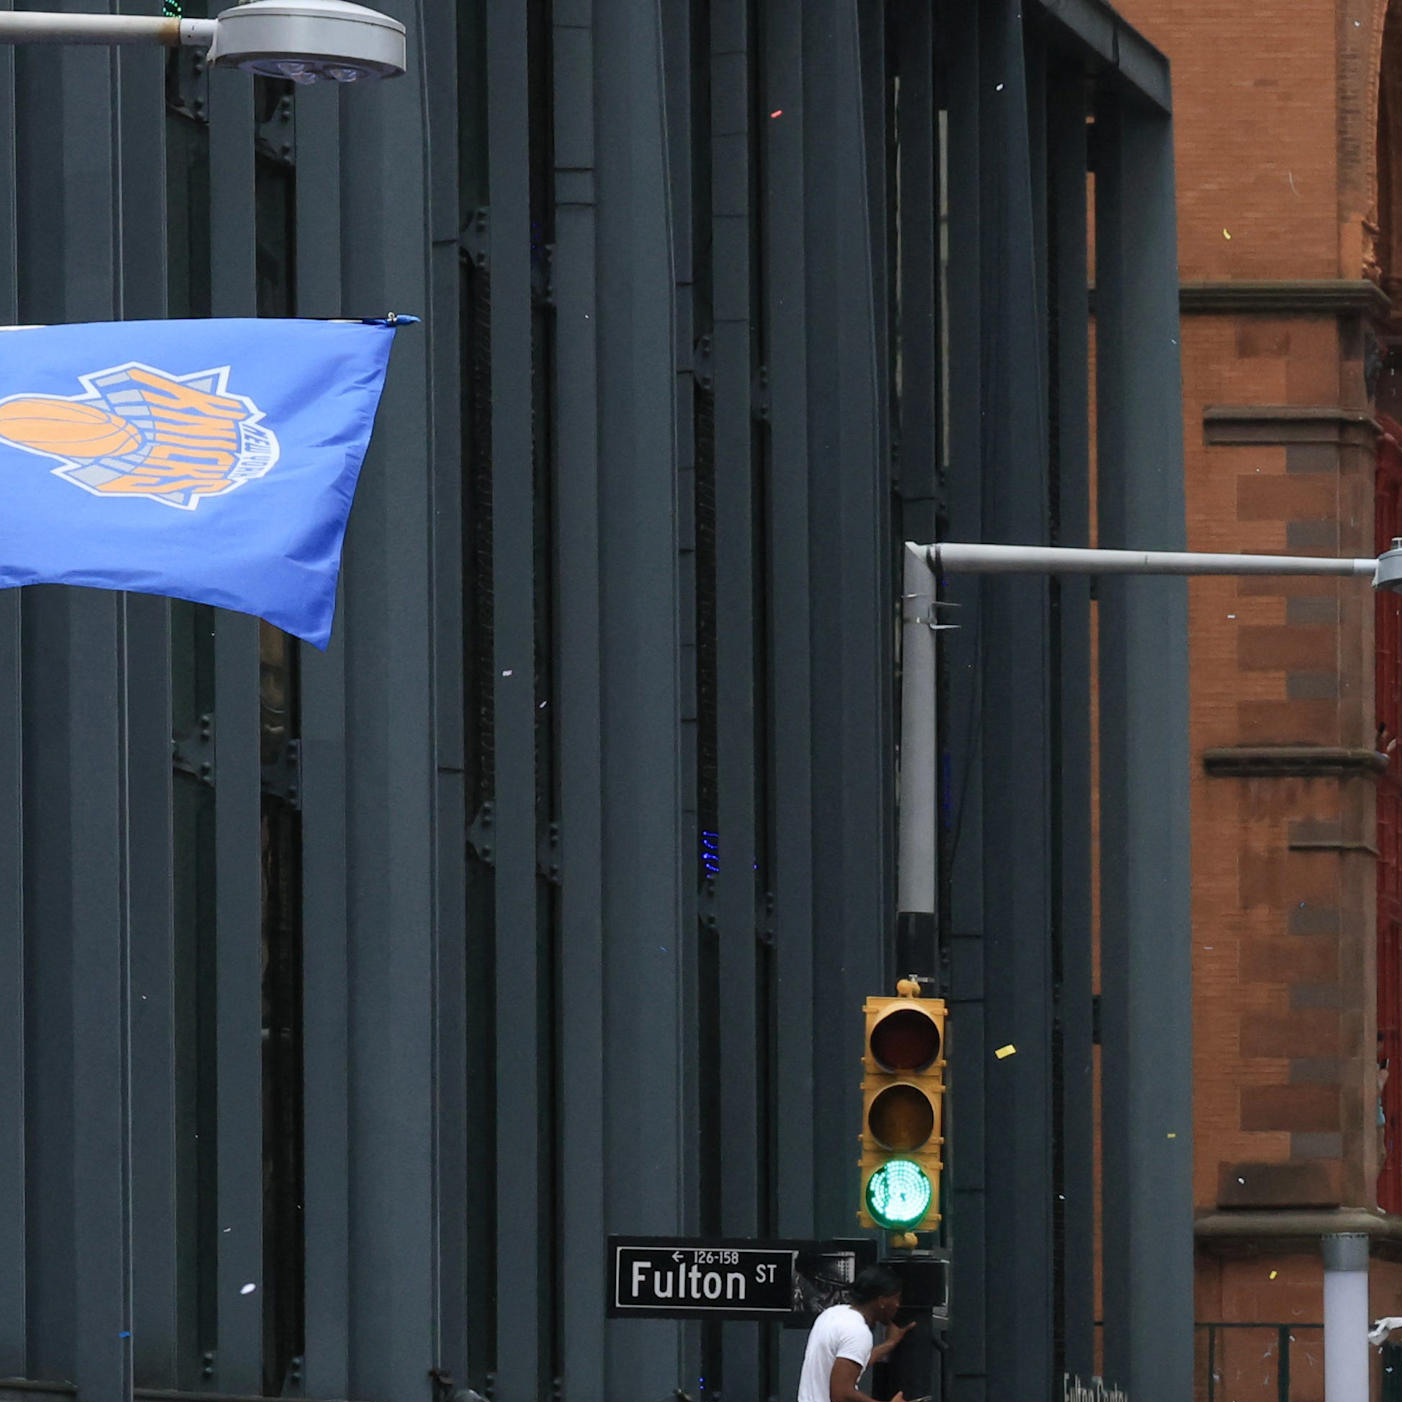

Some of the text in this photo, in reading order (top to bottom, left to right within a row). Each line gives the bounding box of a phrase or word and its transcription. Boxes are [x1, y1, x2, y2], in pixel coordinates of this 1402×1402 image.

[694, 1251, 739, 1265] 126-158
[632, 1261, 778, 1300] Fulton ST
